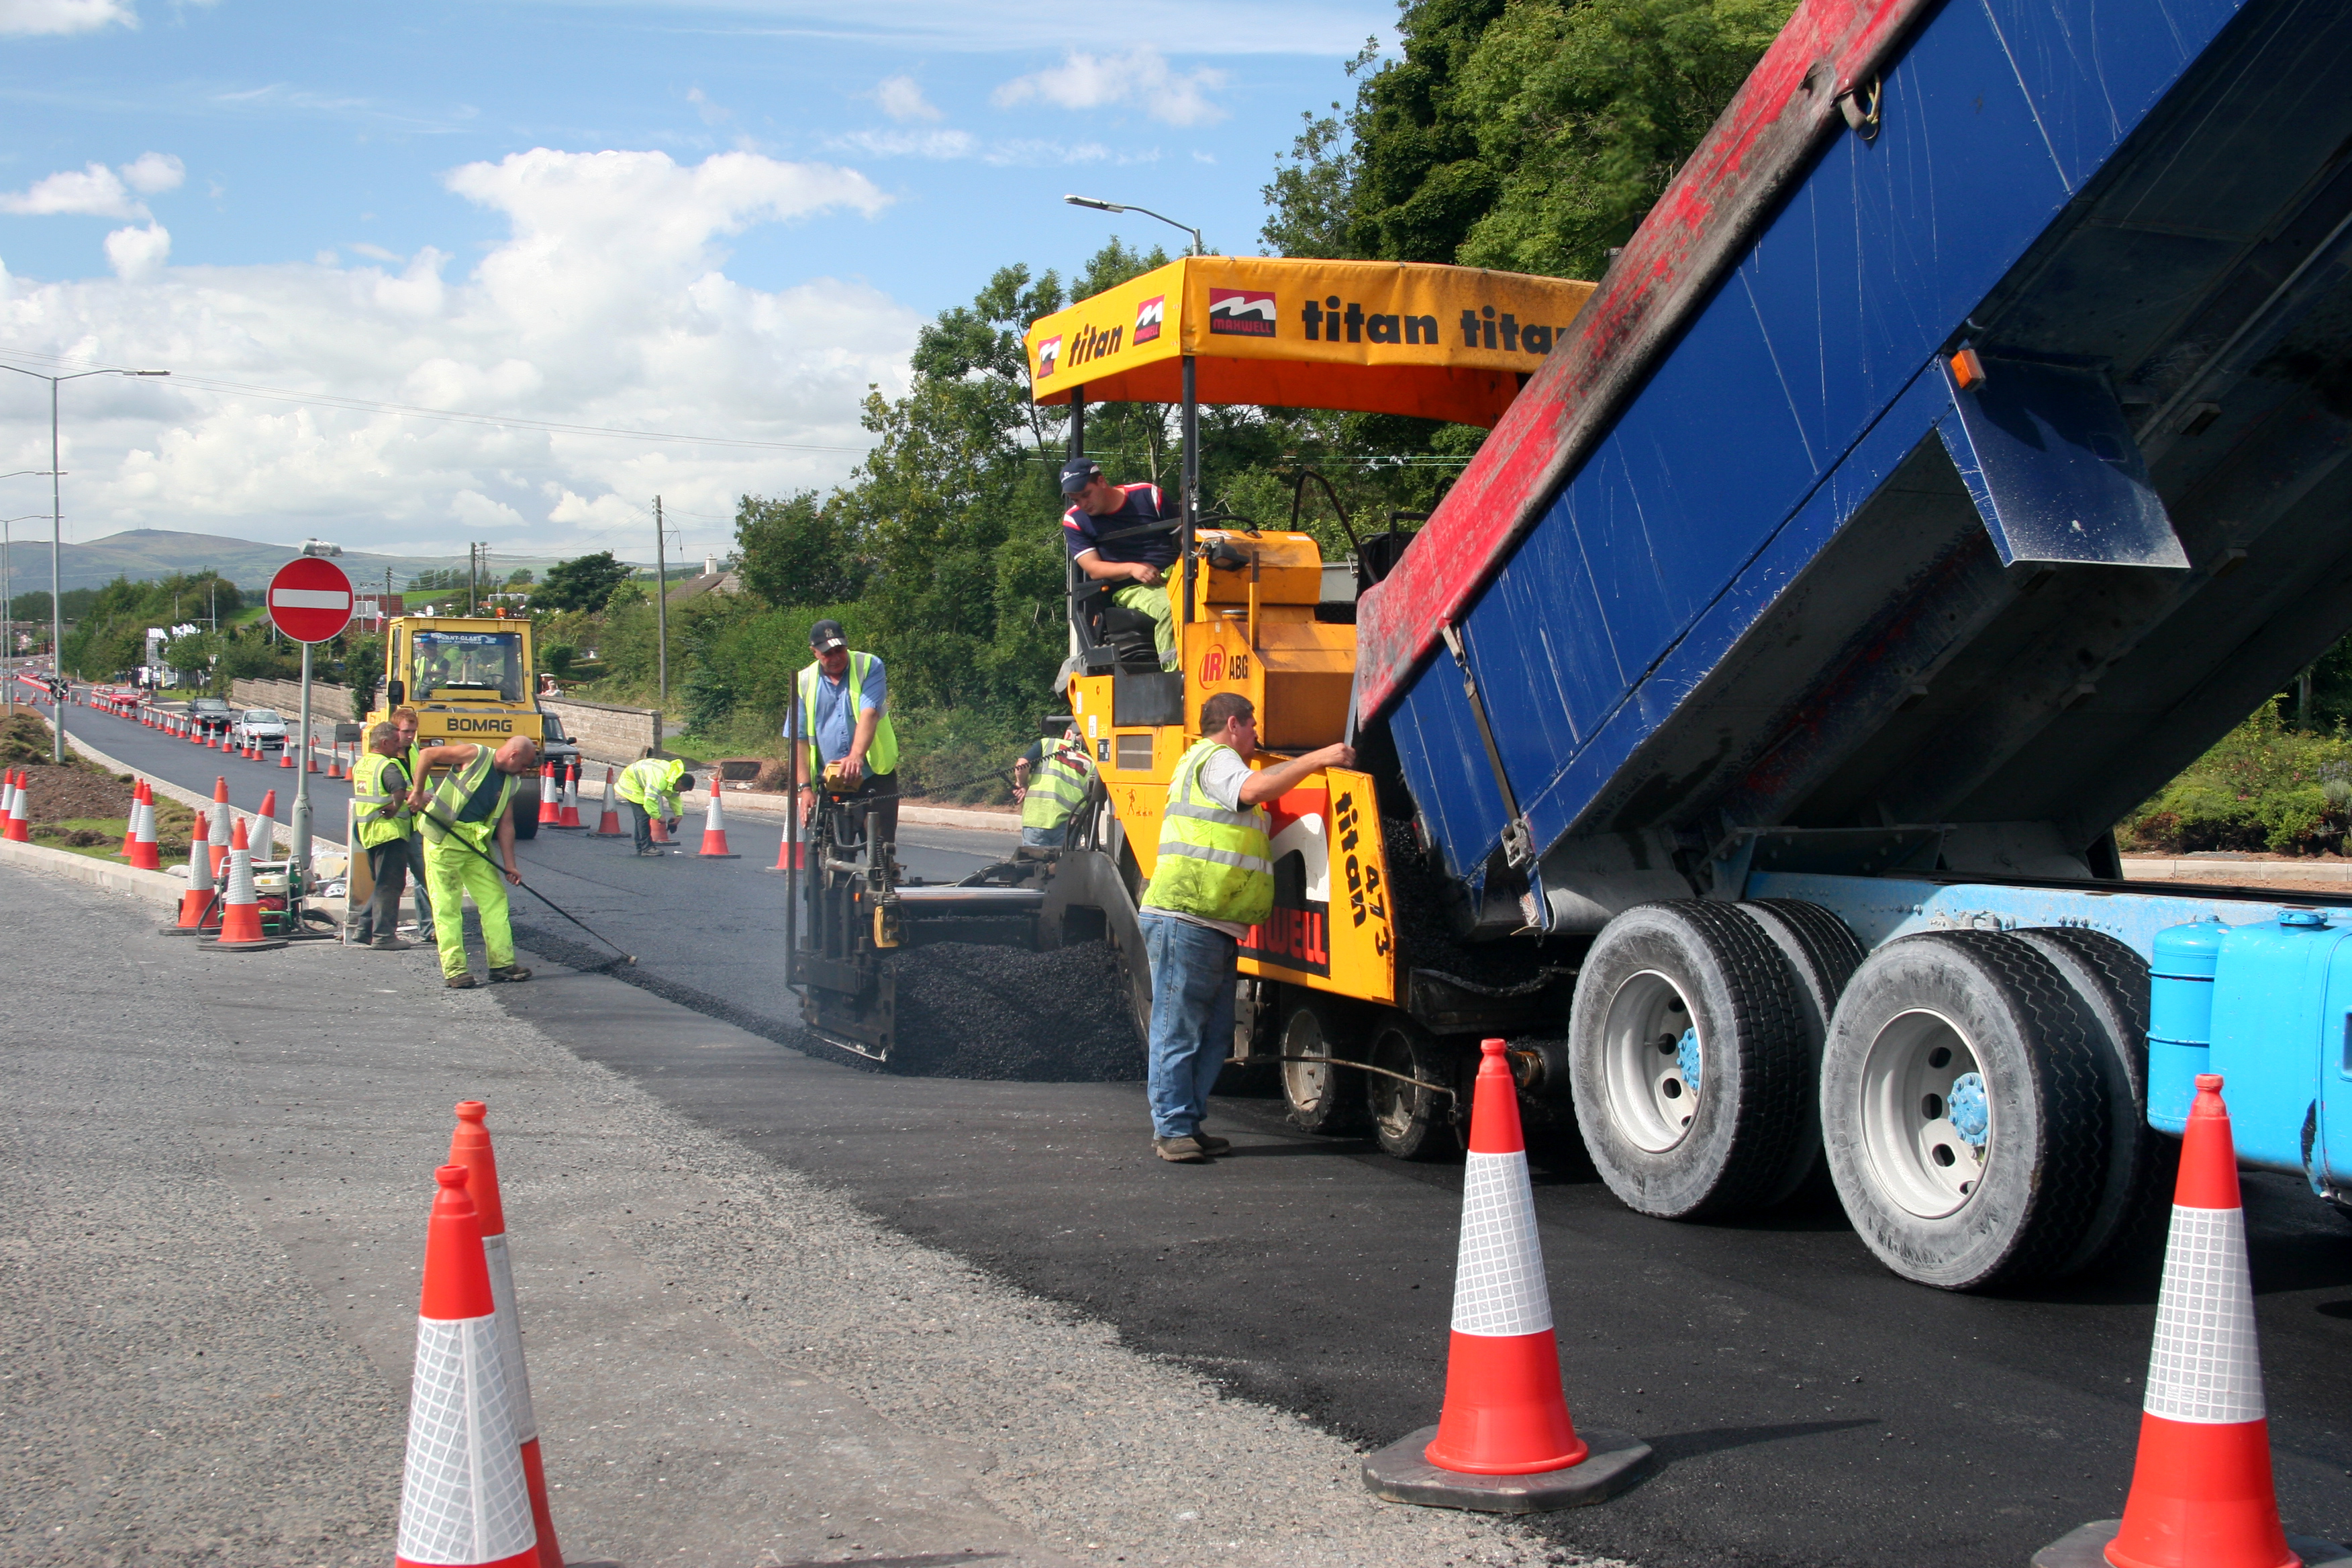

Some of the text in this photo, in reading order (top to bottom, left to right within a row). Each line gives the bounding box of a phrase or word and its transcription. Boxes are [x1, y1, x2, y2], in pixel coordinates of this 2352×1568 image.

[1068, 323, 1123, 368] titan
[1213, 318, 1271, 333] MAXWELL
[1302, 295, 1567, 355] titan tita
[1203, 652, 1248, 681] IR ABG
[447, 718, 512, 732] BOMAG
[1335, 791, 1367, 929] titan
[1237, 905, 1326, 965] WELL
